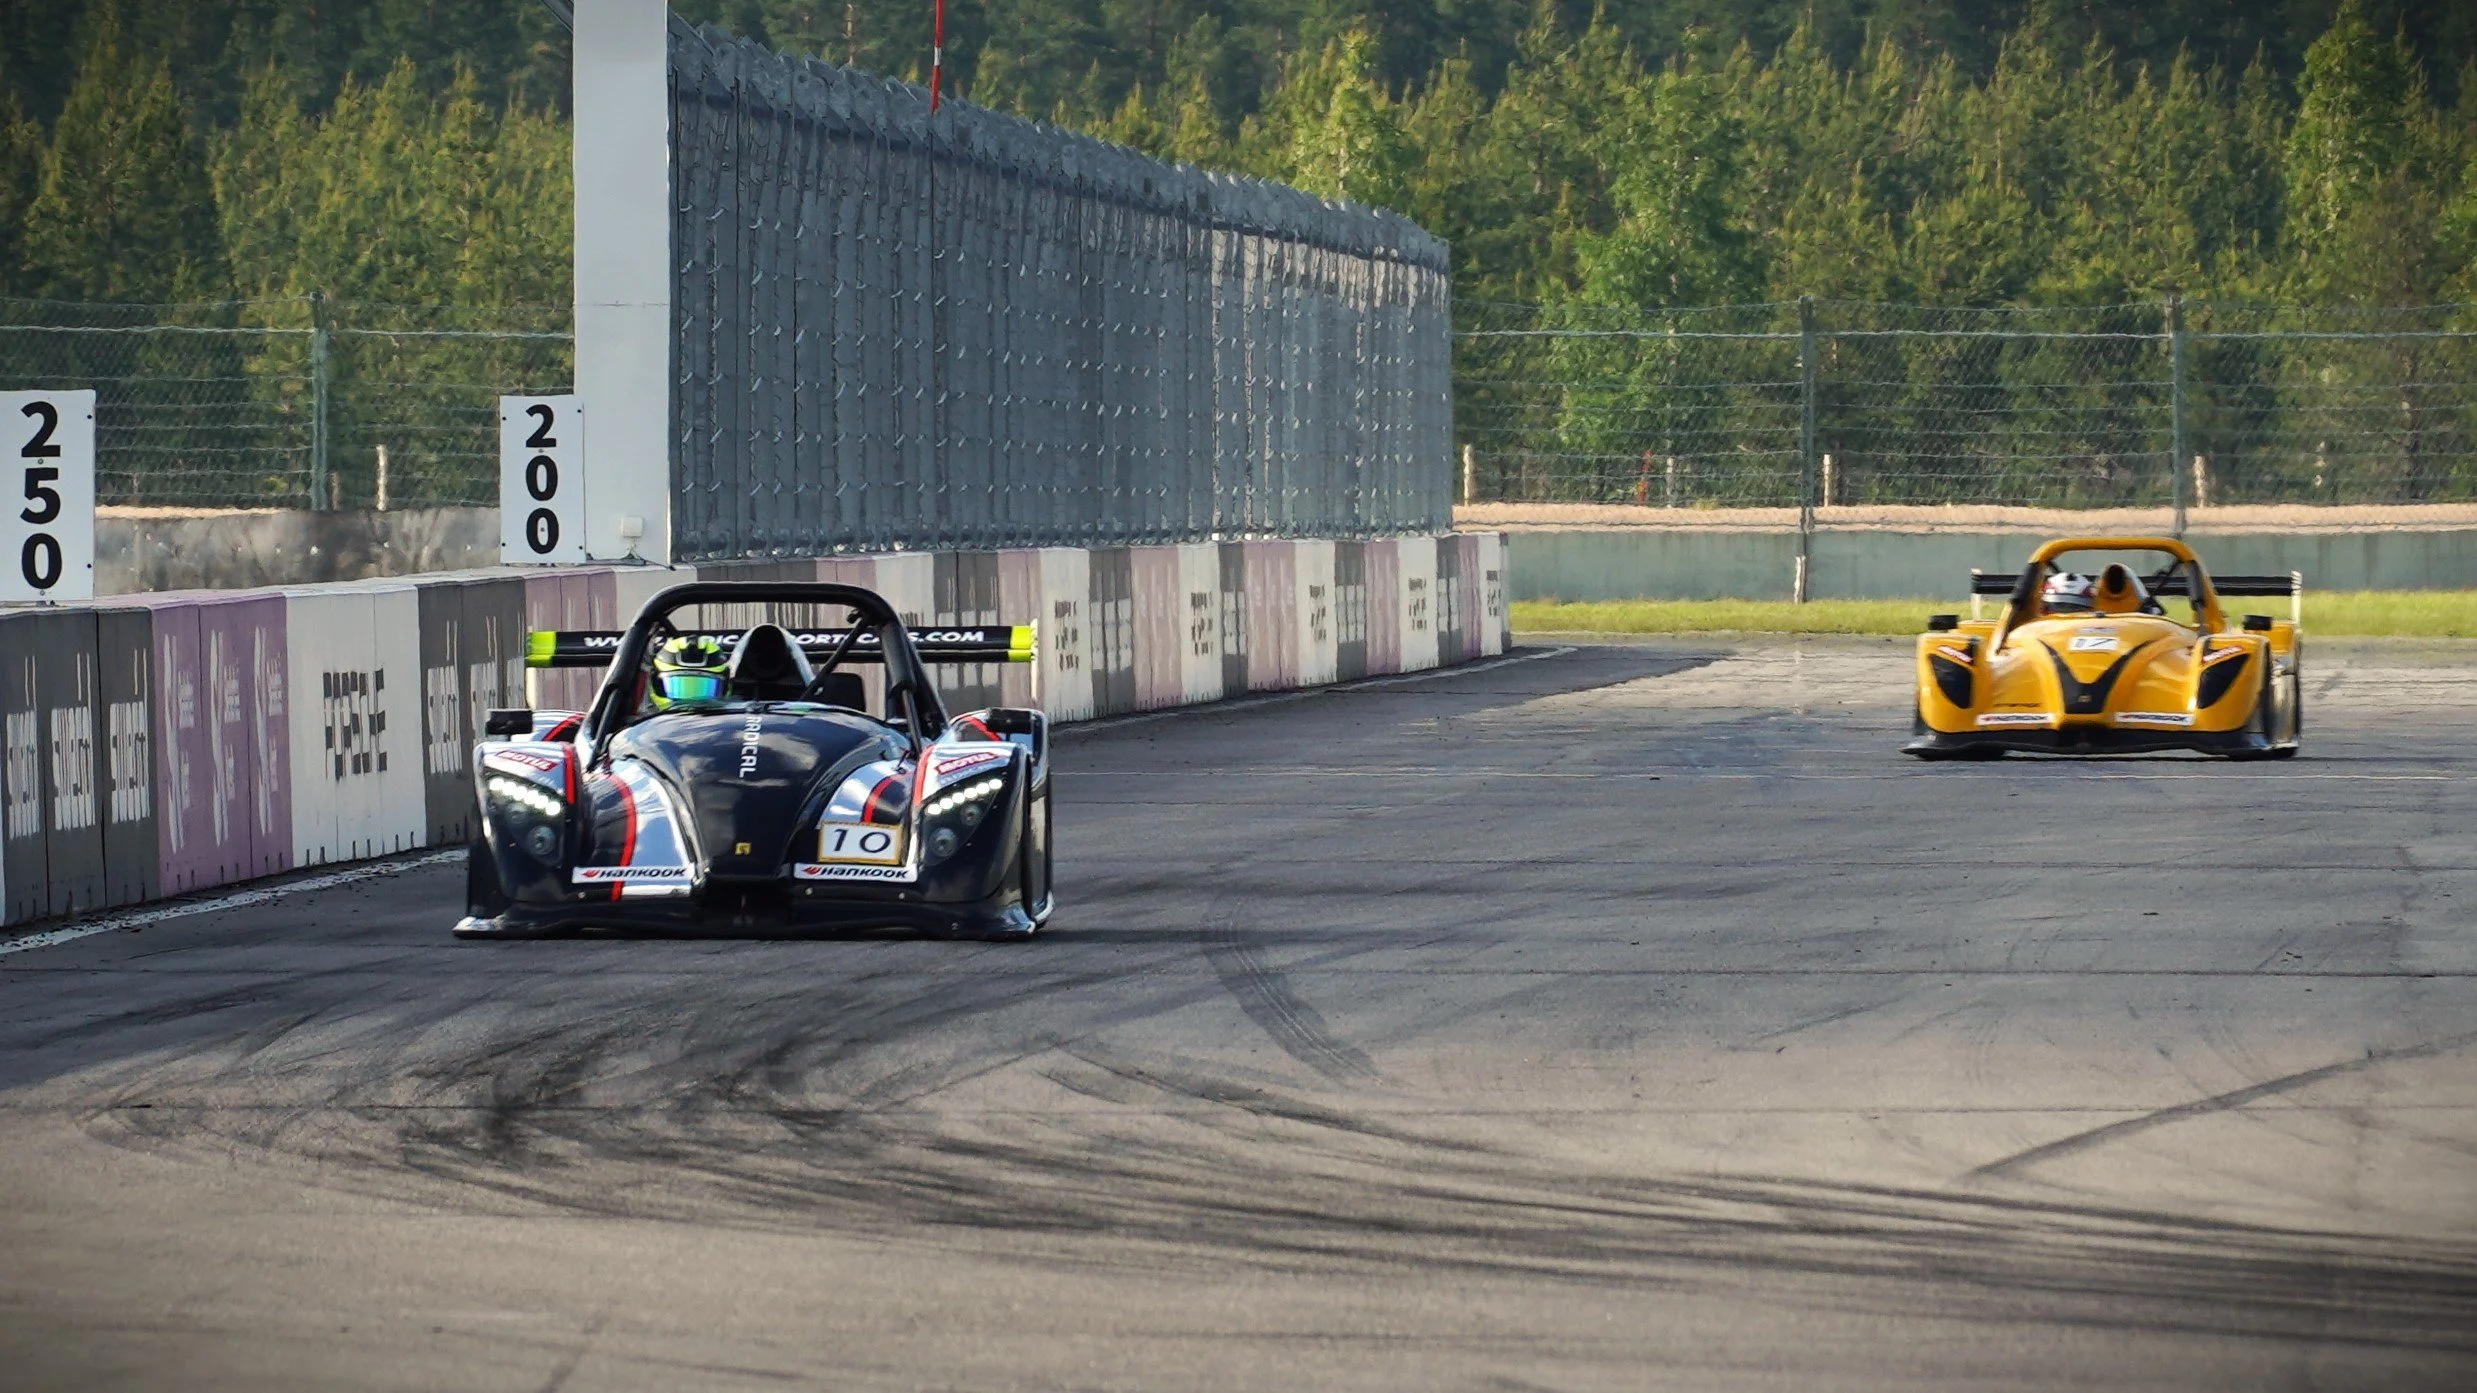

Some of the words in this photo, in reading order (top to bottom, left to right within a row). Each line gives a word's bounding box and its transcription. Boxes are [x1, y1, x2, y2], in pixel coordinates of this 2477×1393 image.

[20, 401, 63, 590] 250
[525, 403, 560, 555] 200
[739, 716, 763, 779] RADICAL
[833, 828, 891, 854] 10
